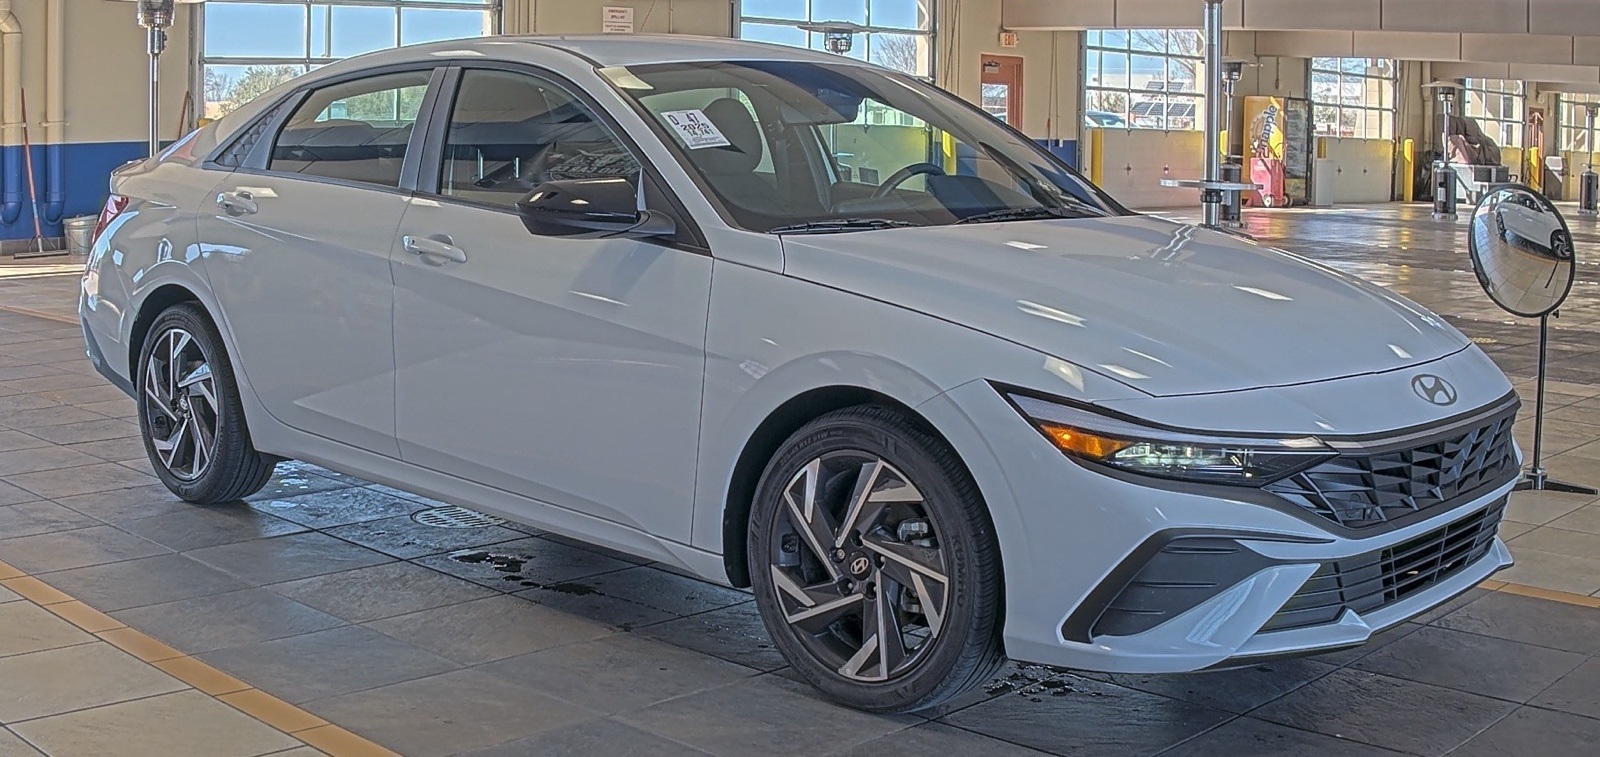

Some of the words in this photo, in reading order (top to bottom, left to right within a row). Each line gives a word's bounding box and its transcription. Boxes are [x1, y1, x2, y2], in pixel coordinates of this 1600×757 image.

[685, 113, 699, 123] 47
[681, 123, 710, 131] 2025
[1259, 105, 1277, 155] napple
